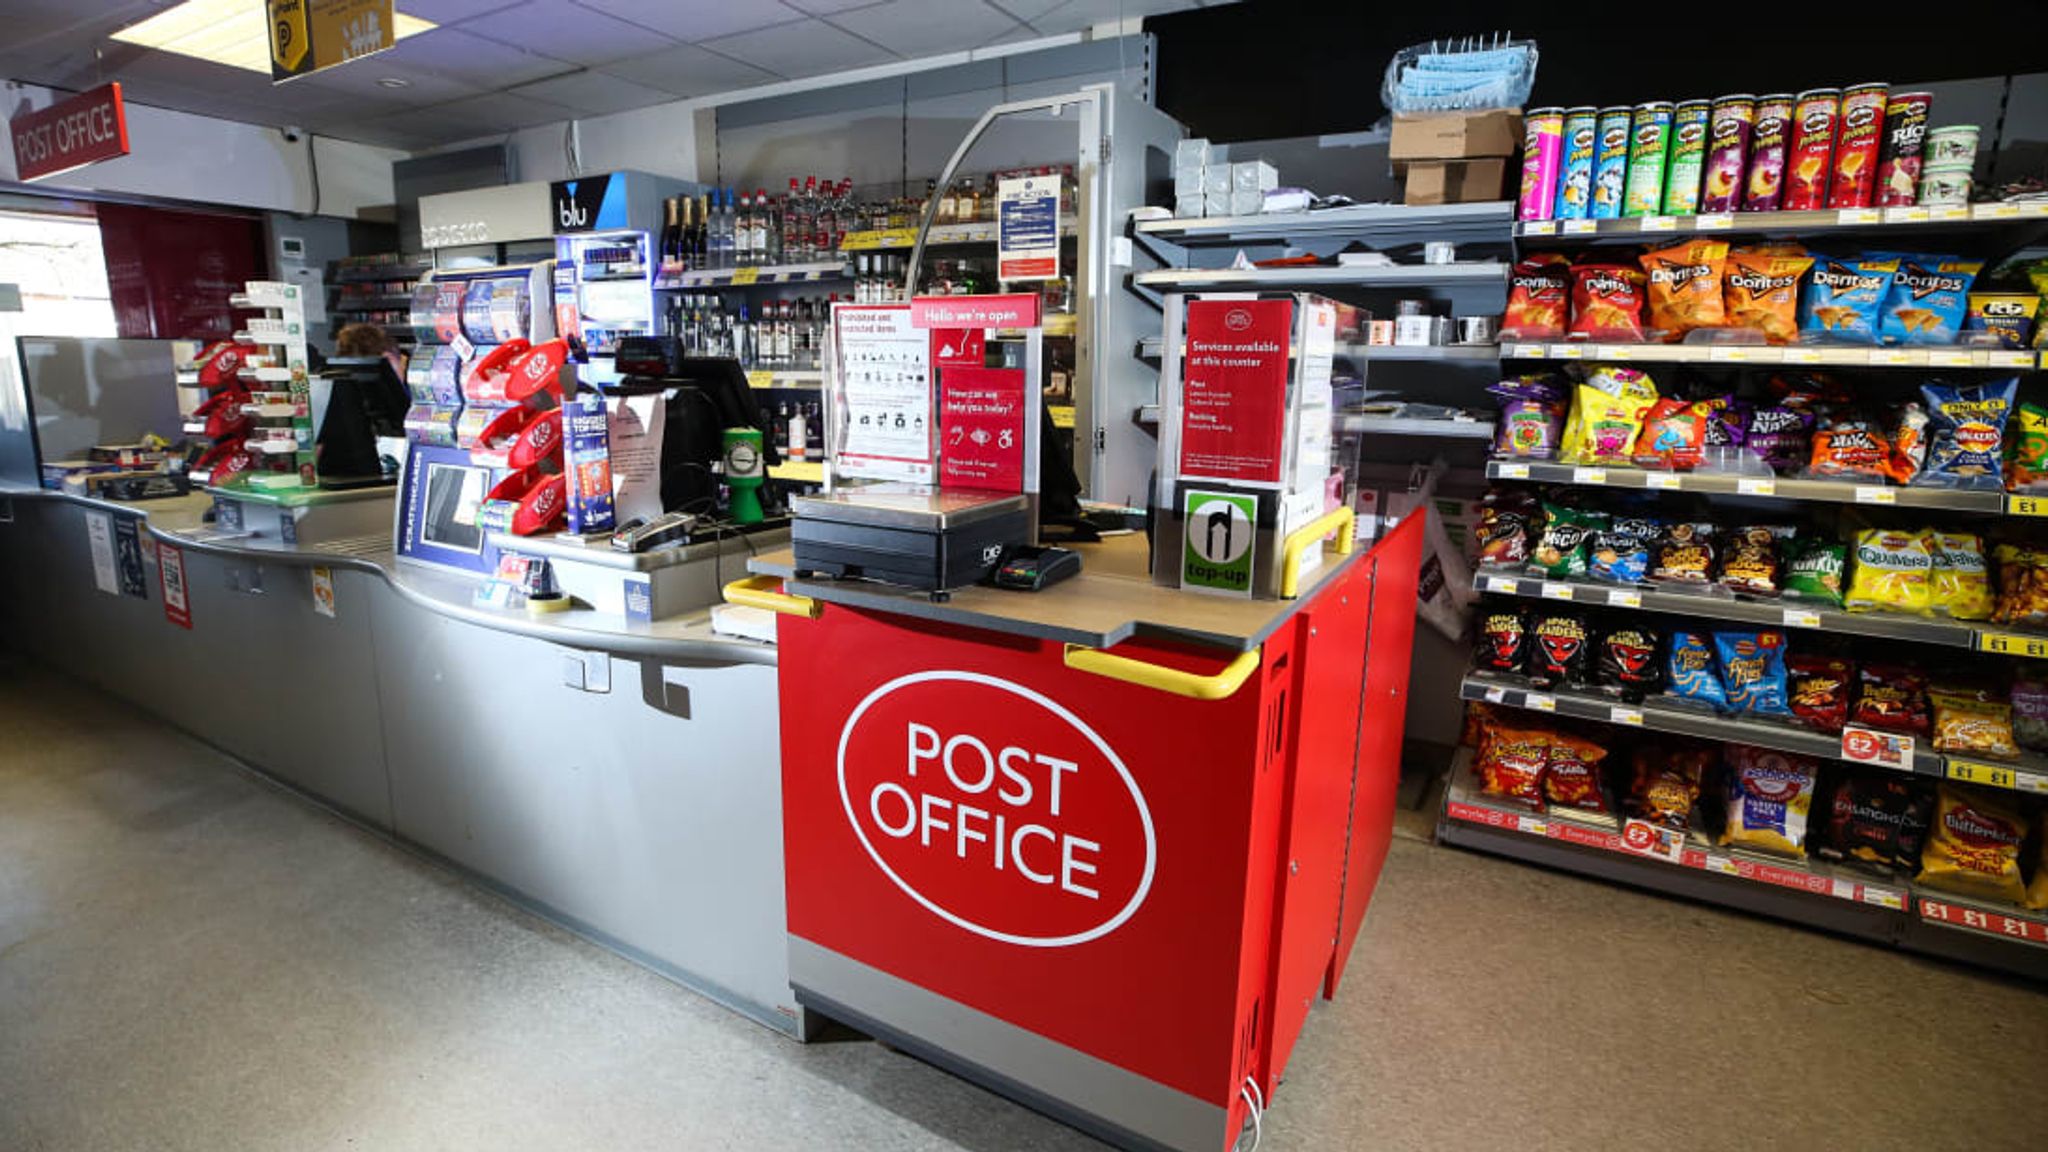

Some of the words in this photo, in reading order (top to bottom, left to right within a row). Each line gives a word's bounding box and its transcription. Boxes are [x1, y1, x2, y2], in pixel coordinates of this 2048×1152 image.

[16, 123, 53, 164] POST
[56, 103, 115, 154] OFFICE
[559, 197, 587, 227] blu
[1651, 264, 1711, 283] Doritos
[1731, 274, 1795, 289] Doritos
[1813, 271, 1884, 291] Doritos
[1892, 271, 1963, 292] Doritos
[1586, 279, 1633, 294] Doritos
[925, 308, 954, 322] Hello
[957, 309, 986, 321] we're
[988, 311, 1018, 323] open
[1192, 340, 1233, 352] Services
[1234, 340, 1280, 353] available
[1191, 357, 1201, 367] at
[1202, 355, 1221, 367] this
[1222, 358, 1261, 367] counter
[1189, 563, 1247, 584] top-up
[1848, 737, 1872, 753] £2
[907, 721, 1079, 816] POST
[870, 782, 1101, 900] OFFICE
[1627, 829, 1648, 844] £2
[1925, 902, 1948, 920] £1
[1964, 910, 1987, 929] £1
[2003, 918, 2029, 936] £1
